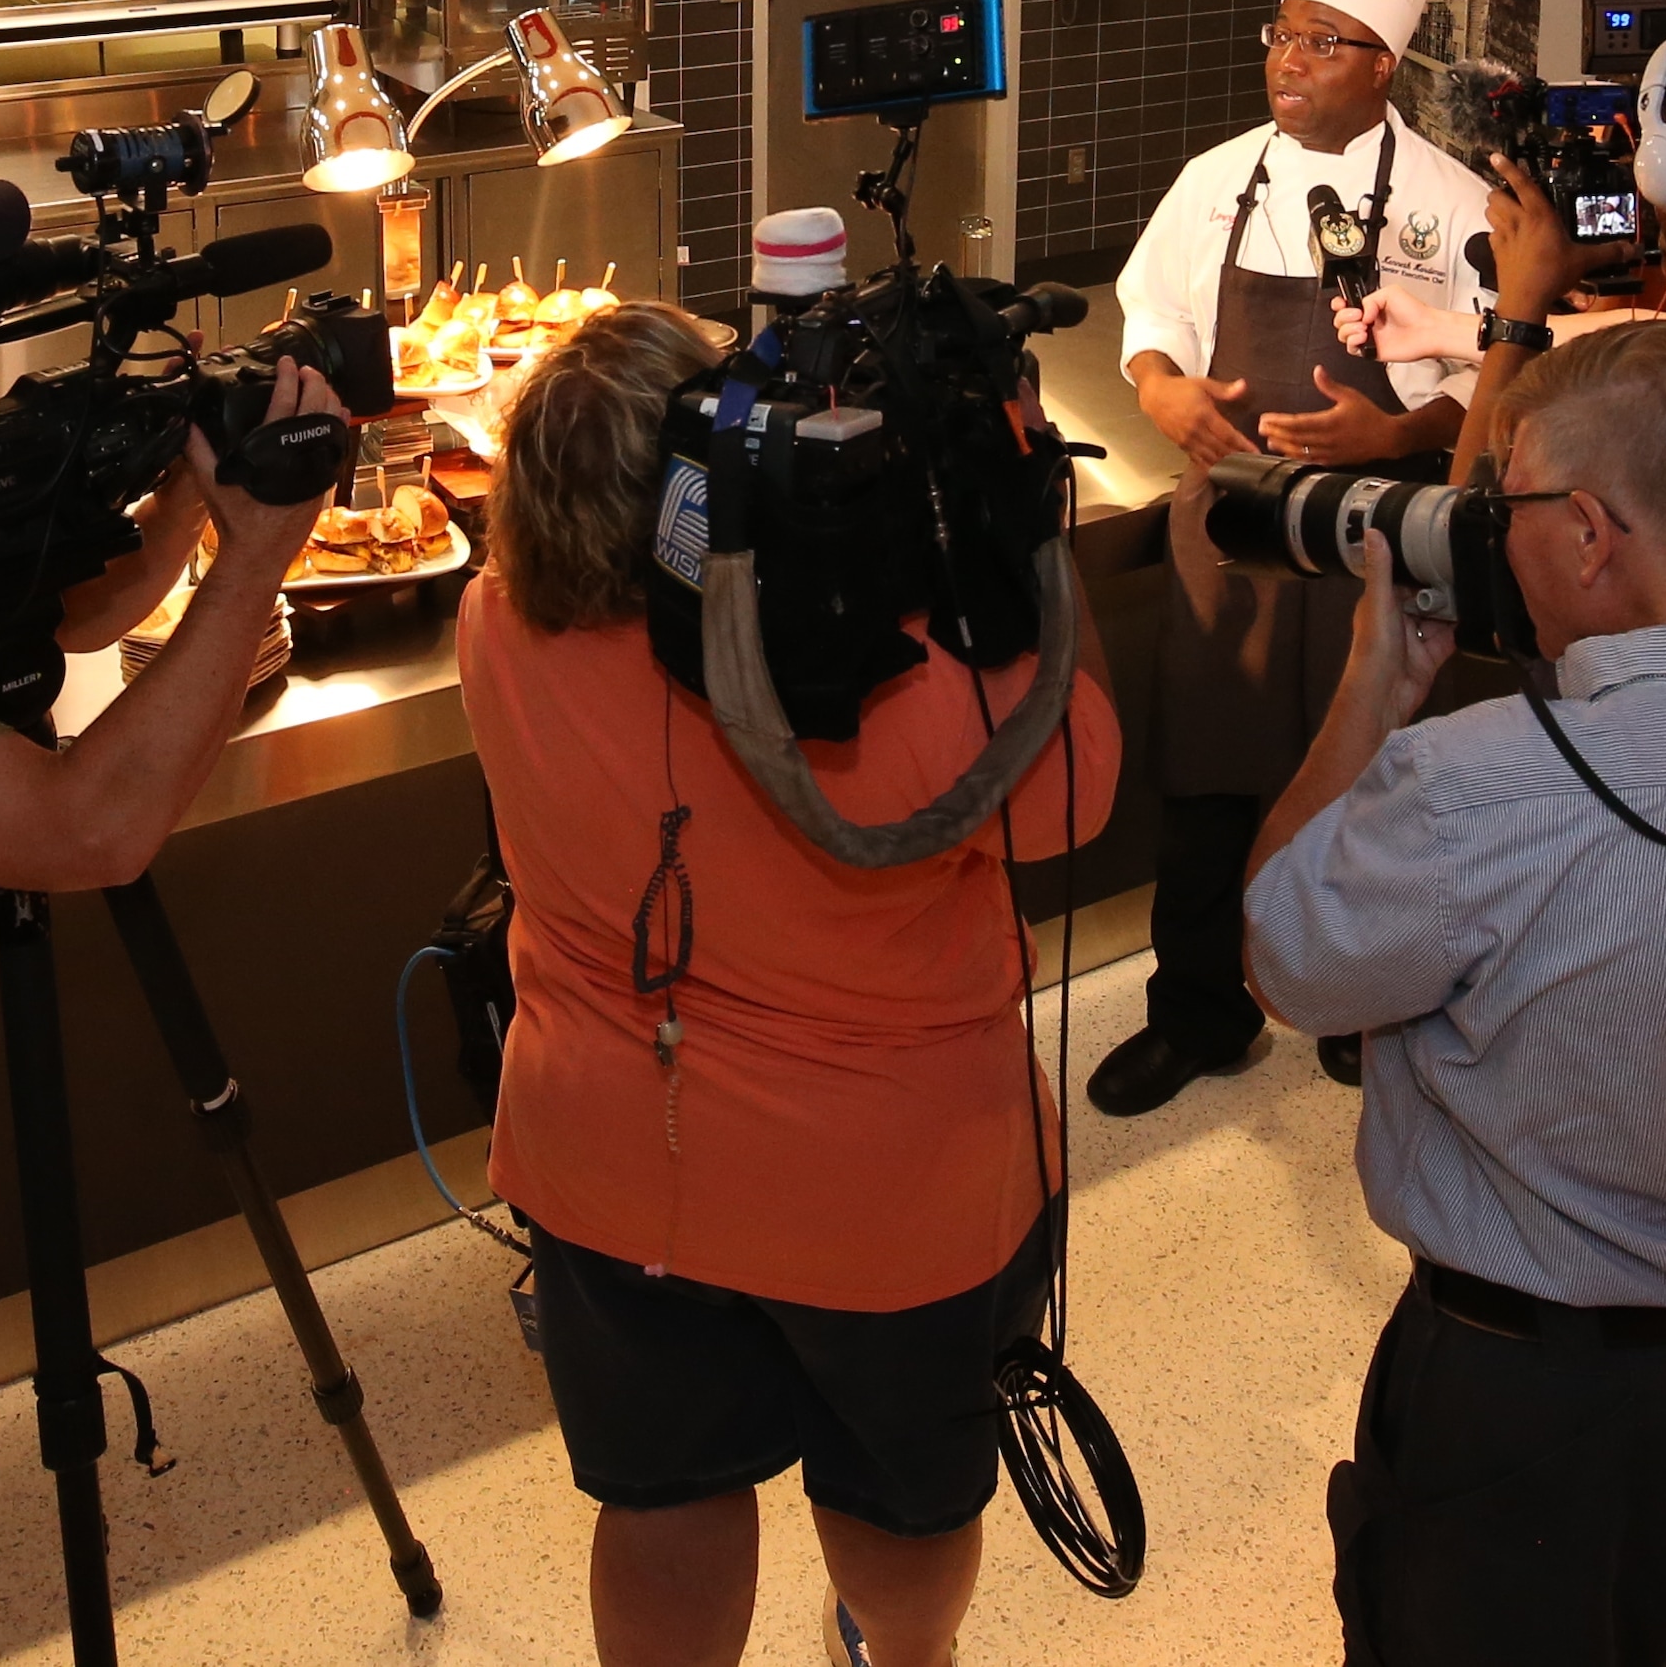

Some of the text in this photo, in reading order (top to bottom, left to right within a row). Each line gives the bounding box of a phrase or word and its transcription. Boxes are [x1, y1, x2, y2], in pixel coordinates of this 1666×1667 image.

[1611, 13, 1630, 27] 99
[280, 424, 331, 446] FUJINON
[2, 673, 37, 693] MILLER
